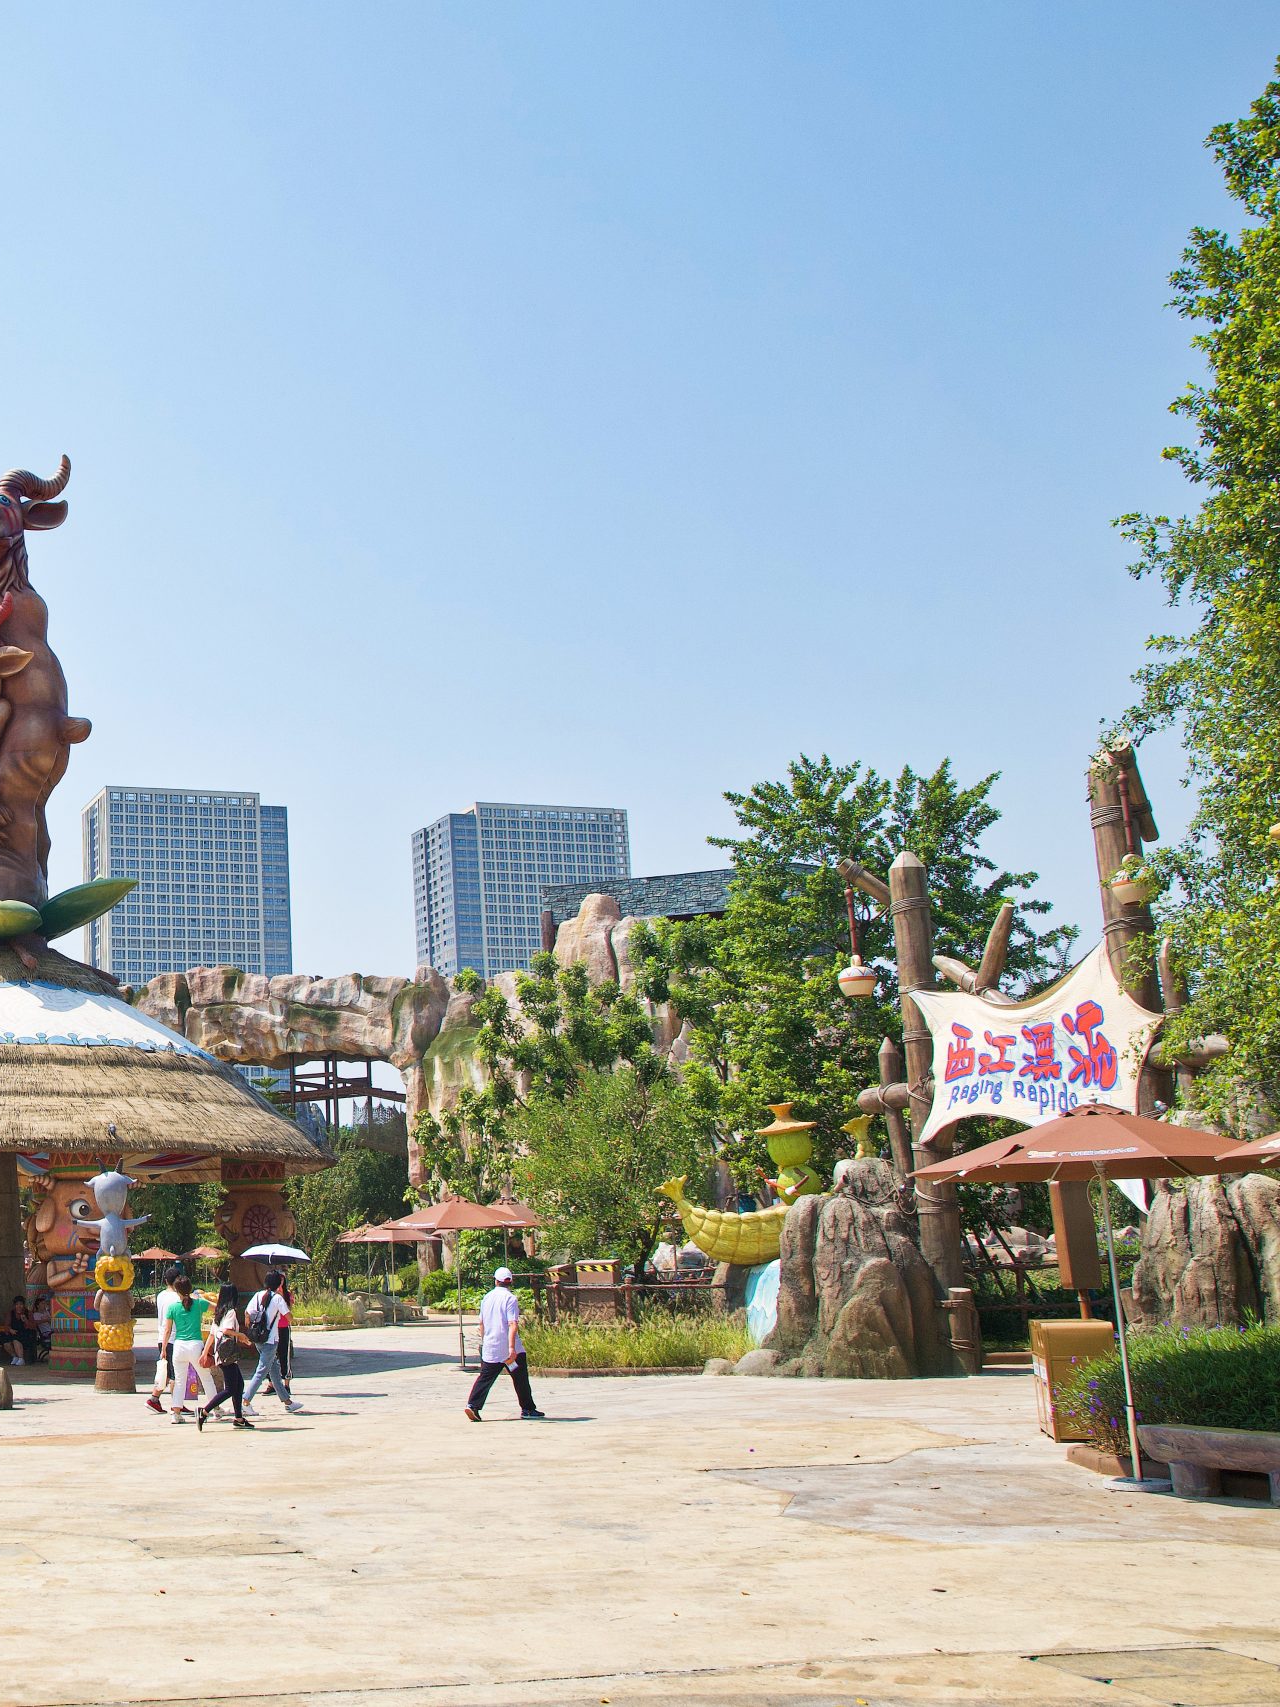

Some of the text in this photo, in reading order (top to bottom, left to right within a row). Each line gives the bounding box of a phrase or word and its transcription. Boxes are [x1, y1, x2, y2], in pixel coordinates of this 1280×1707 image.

[945, 1000, 1118, 1091] 西江漂流
[947, 1079, 1003, 1111] Raging
